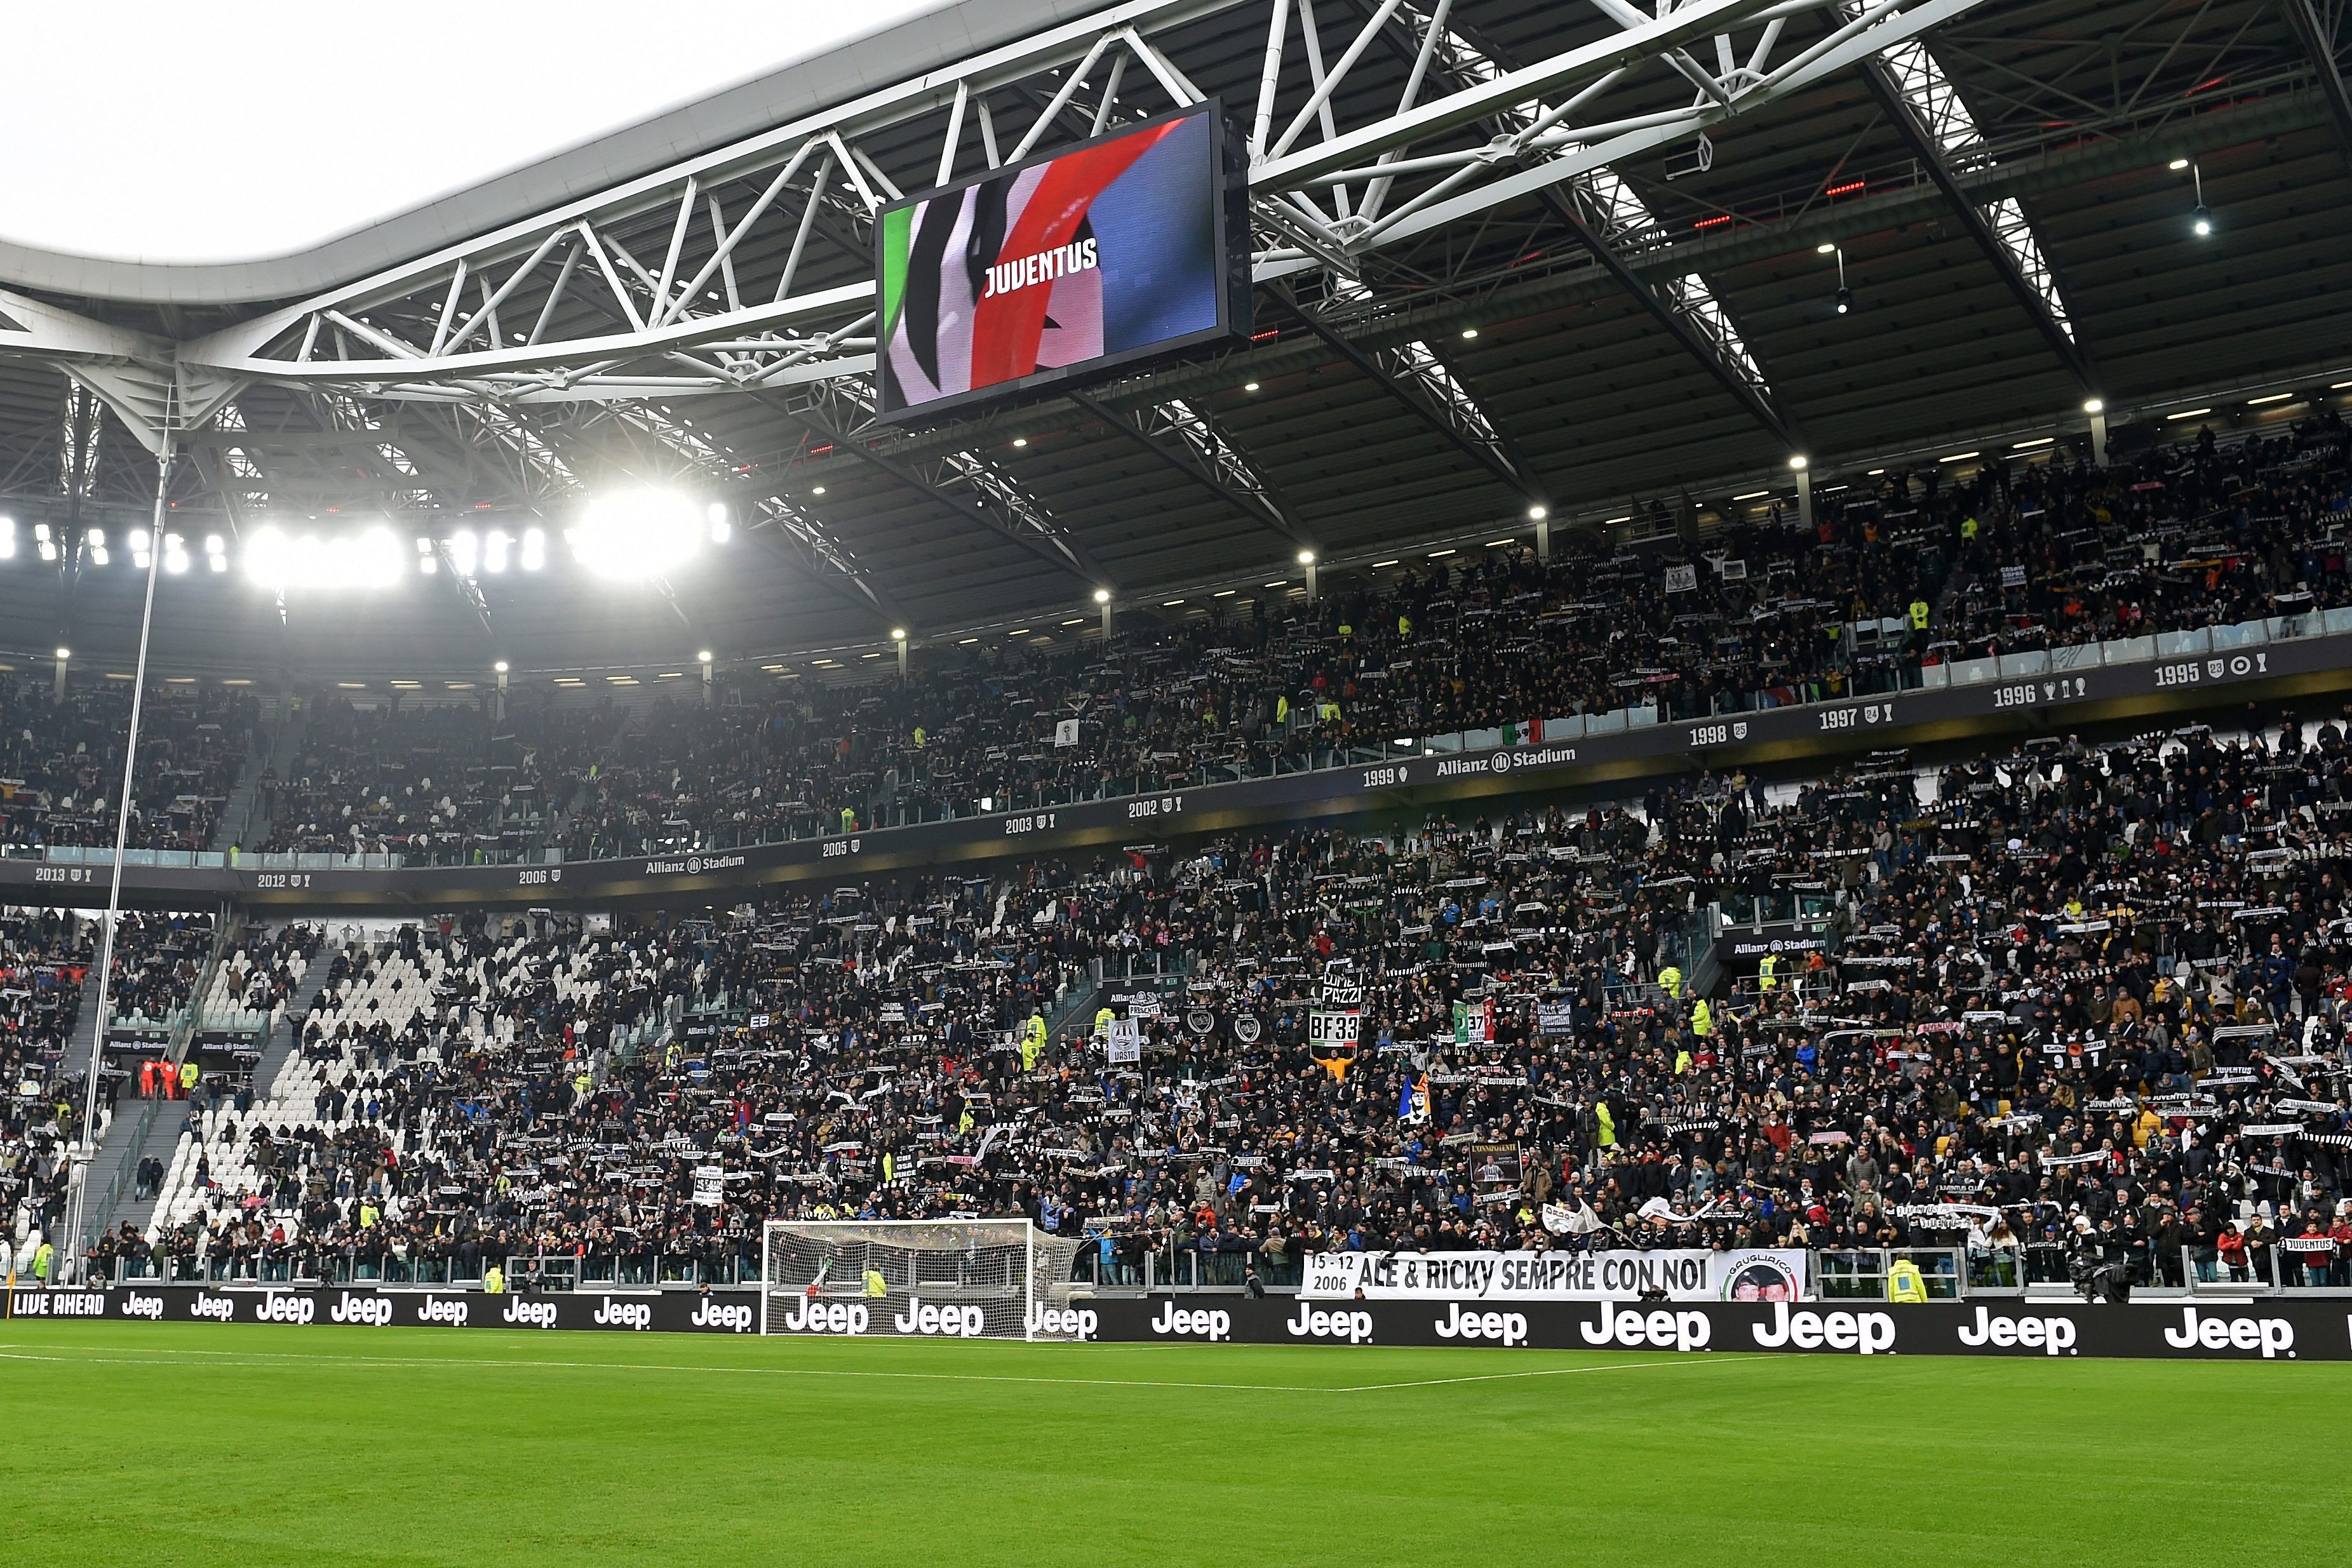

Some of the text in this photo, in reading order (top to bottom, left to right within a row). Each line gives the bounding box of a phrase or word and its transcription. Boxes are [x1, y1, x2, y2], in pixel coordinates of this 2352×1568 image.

[984, 238, 1098, 298] JUVENTUS
[2155, 663, 2222, 687] 1995 23
[1994, 685, 2036, 707] 1996
[1820, 708, 1877, 730] 1997 24
[1690, 725, 1745, 746] 1998 25
[1437, 748, 1576, 777] Allianz Stadium
[1364, 768, 1395, 787] 1999
[1129, 800, 1172, 818] 2002 26
[1005, 817, 1032, 834] 2003
[823, 841, 847, 857] 2005
[36, 868, 65, 881] 2013
[645, 855, 744, 874] Allianz Stadium
[259, 875, 285, 888] 2012
[520, 871, 547, 884] 2006
[1735, 939, 1825, 954] Allianz Stadium
[1324, 972, 1355, 986] COME
[1855, 980, 1881, 989] JUVENTUS
[1322, 986, 1362, 1004] PAZZI
[687, 1026, 708, 1035] Allianz
[1469, 1016, 1484, 1030] 37
[1923, 1022, 1955, 1030] JUVENTUS
[1115, 1052, 1136, 1061] VASTO
[2217, 1067, 2252, 1075] JUVENTUS
[2089, 1101, 2127, 1109] JUVENTUS
[2153, 1093, 2191, 1101] JUVENTUS
[893, 1170, 917, 1179] VINCE
[1897, 1205, 1939, 1217] JUVENTUS
[1919, 1217, 1966, 1230] JUVENTUS
[2288, 1240, 2331, 1250] JUVENTUS
[1340, 1256, 1354, 1270] 12
[1729, 1254, 1792, 1275] GRUGLIASCO
[1314, 1275, 1347, 1291] 2006
[1358, 1257, 1399, 1287] ALE
[1404, 1259, 1419, 1288] &
[1501, 1259, 1594, 1290] SEMPRE
[1603, 1258, 1654, 1291] CON
[13, 1294, 105, 1315] LIVE AHEAD
[123, 1291, 163, 1320] Jeep
[191, 1292, 233, 1321] Jeep
[257, 1290, 314, 1324] Jeep
[331, 1291, 392, 1326] Jeep
[419, 1295, 467, 1326] Jeep
[504, 1296, 556, 1328] Jeep
[595, 1297, 650, 1330] Jeep
[692, 1297, 751, 1332] Jeep
[786, 1296, 868, 1334] Jeep
[896, 1297, 983, 1337] Jeep
[1152, 1301, 1230, 1341] Jeep
[1287, 1303, 1373, 1343] Jeep
[1435, 1303, 1528, 1346] Jeep
[1580, 1301, 1710, 1351] Jeep
[1752, 1301, 1896, 1354] Jeep
[1958, 1306, 2077, 1355] Jeep
[2165, 1308, 2295, 1357] Jeep
